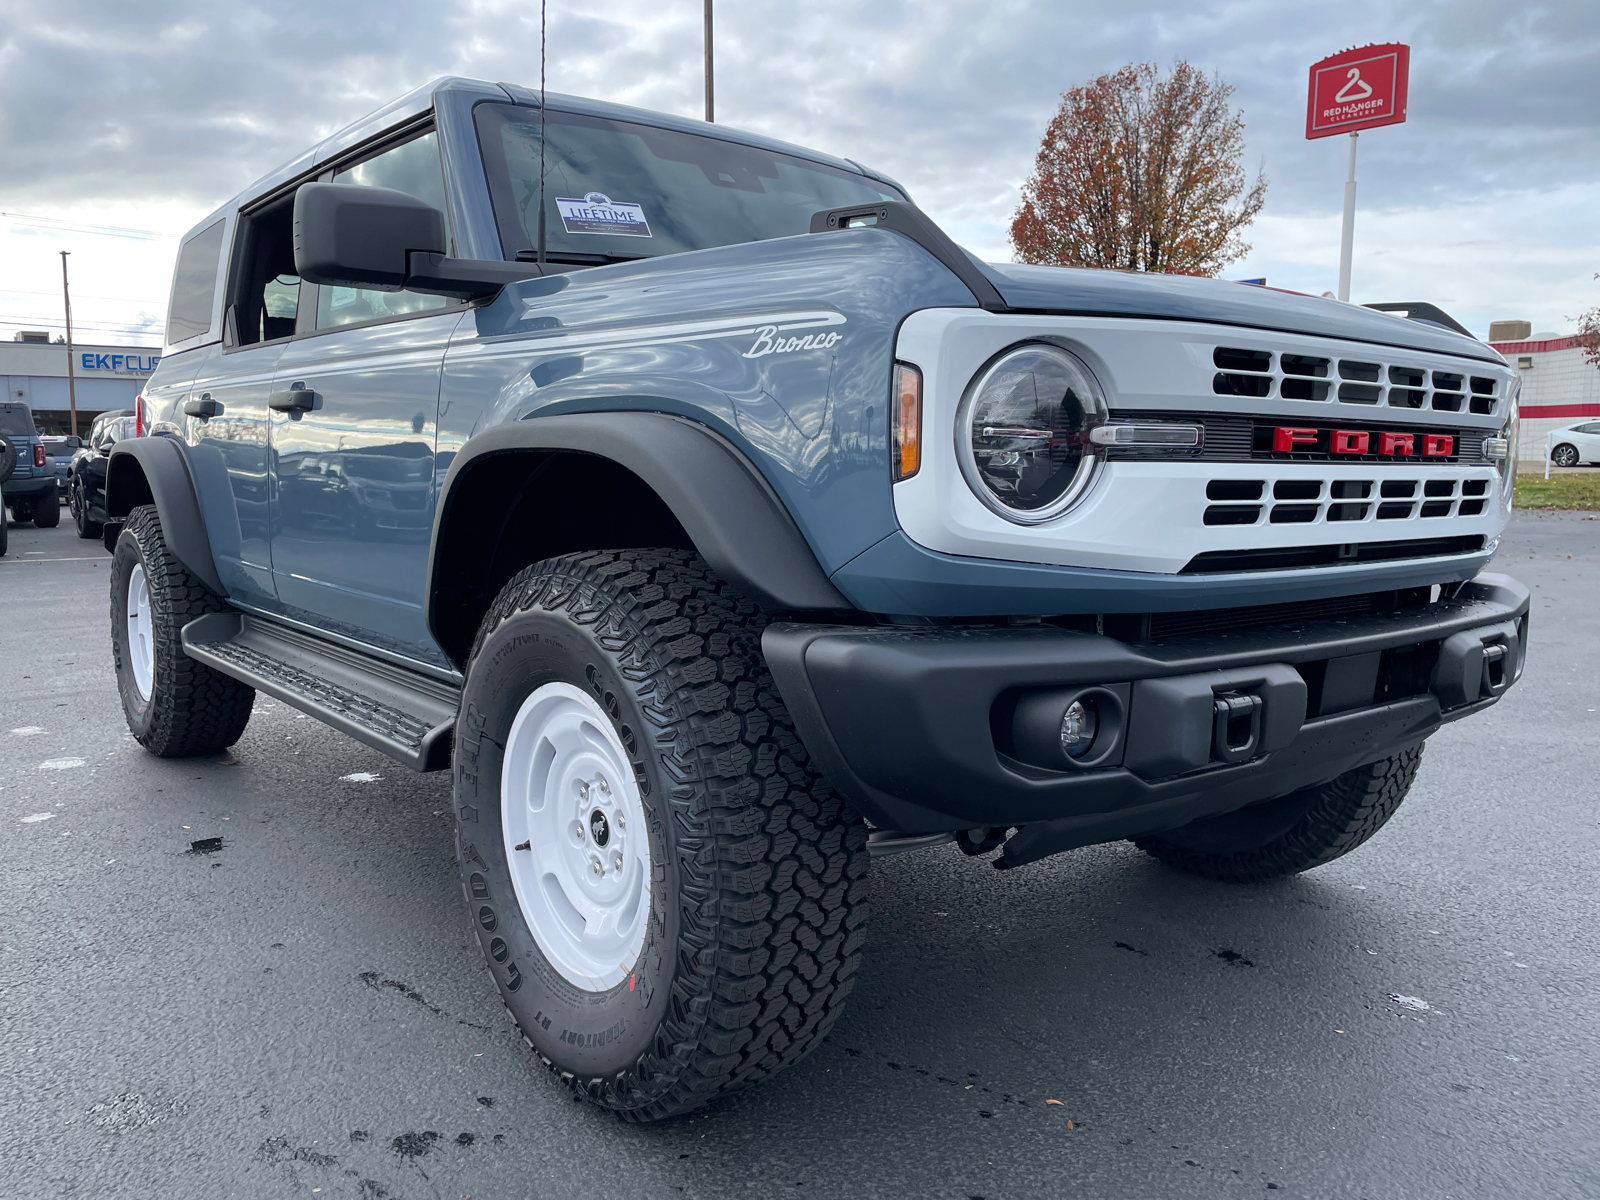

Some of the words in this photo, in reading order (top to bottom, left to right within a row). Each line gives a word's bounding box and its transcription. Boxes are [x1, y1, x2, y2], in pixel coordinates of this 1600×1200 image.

[1323, 107, 1341, 117] RED
[1343, 98, 1383, 113] HANGER
[1330, 109, 1375, 122] CLEANERS
[570, 208, 637, 221] LIFETIME
[742, 325, 843, 359] Bronco
[1273, 427, 1453, 456] FORD
[533, 1010, 552, 1031] RT
[560, 1017, 627, 1049] TERRITORY
